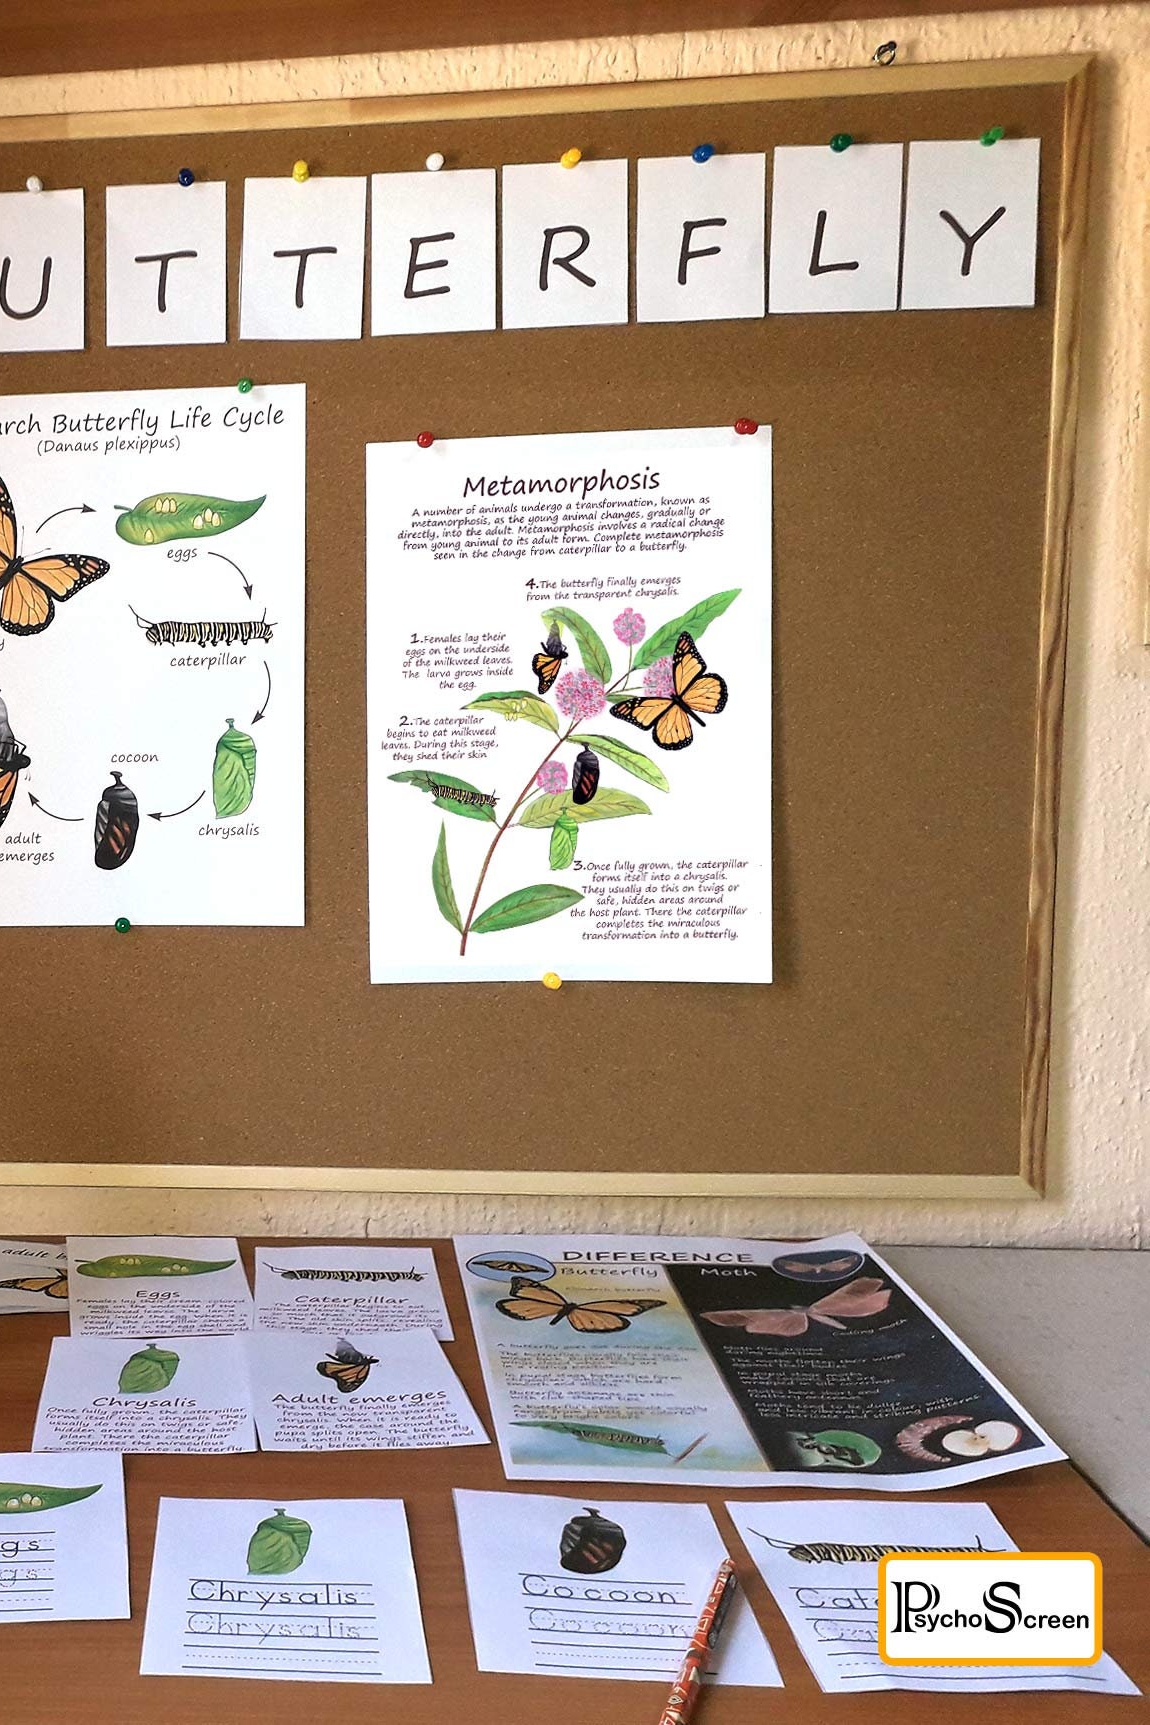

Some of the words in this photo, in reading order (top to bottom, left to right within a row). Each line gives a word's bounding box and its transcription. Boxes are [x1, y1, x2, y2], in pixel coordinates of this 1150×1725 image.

[52, 409, 159, 437] Butterfly
[171, 406, 212, 428] Life
[223, 404, 285, 433] Cycle
[37, 439, 99, 457] (Danaus
[104, 435, 181, 455] plexippus)
[462, 466, 661, 501] Metamorphosis
[412, 507, 420, 516] A
[423, 505, 463, 515] number
[465, 505, 476, 513] of
[478, 503, 518, 513] animals
[521, 501, 562, 513] undergo
[660, 495, 695, 505] known
[508, 514, 525, 523] the
[527, 515, 558, 525] young
[562, 511, 598, 521] animal
[646, 507, 695, 520] gradually
[442, 527, 462, 536] into
[465, 526, 482, 536] the
[517, 522, 594, 536] Metamorphosis
[597, 521, 638, 531] involves
[650, 519, 686, 529] radical
[688, 518, 725, 530] change
[403, 539, 427, 548] from
[430, 540, 461, 551] young
[464, 536, 499, 546] animal
[502, 536, 513, 545] to
[516, 535, 529, 544] its
[531, 534, 559, 544] adult
[593, 531, 643, 544] Complete
[644, 528, 724, 542] metamorphosis
[167, 549, 198, 562] eggs
[458, 549, 468, 558] in
[472, 548, 488, 557] the
[491, 547, 526, 559] change
[530, 546, 556, 555] from
[558, 544, 612, 557] caterpillar
[615, 543, 626, 552] to
[560, 578, 604, 589] butterfly
[606, 577, 637, 588] finally
[640, 578, 681, 587] emerges
[526, 591, 550, 601] from
[554, 590, 569, 599] the
[572, 588, 632, 601] transparent
[464, 633, 479, 644] lay
[481, 632, 506, 641] their
[405, 647, 426, 658] eggs
[444, 645, 460, 653] the
[463, 644, 510, 653] underside
[170, 653, 247, 669] caterpillar
[403, 657, 414, 668] of
[415, 657, 430, 666] the
[434, 656, 480, 665] milkweed
[402, 669, 420, 678] The
[426, 668, 450, 677] larva
[454, 670, 483, 679] grows
[486, 667, 513, 676] inside
[439, 680, 454, 689] the
[433, 716, 484, 727] caterpillar
[386, 728, 416, 740] begins
[418, 728, 429, 736] to
[432, 728, 448, 736] eat
[451, 727, 496, 736] milkweed
[413, 739, 447, 751] During
[449, 739, 468, 748] this
[110, 752, 159, 764] cocoon
[392, 751, 414, 762] they
[416, 750, 438, 759] shed
[441, 750, 466, 759] their
[467, 750, 487, 758] skin
[5, 832, 42, 845] adult
[198, 824, 260, 840] chrysalis
[2, 1248, 49, 1259] adult
[563, 1251, 755, 1263] DIFFERENCE
[561, 1266, 659, 1278] Butterfly
[700, 1267, 758, 1277] Moth
[136, 1290, 180, 1300] Eggs
[295, 1295, 409, 1306] Caterpillar
[92, 1397, 197, 1409] Chrysalis
[272, 1393, 339, 1404] Adult
[349, 1390, 447, 1405] emerges
[190, 1579, 357, 1611] Chrysalis
[522, 1574, 677, 1604] Cocoon
[188, 1612, 360, 1645] Chrysalis
